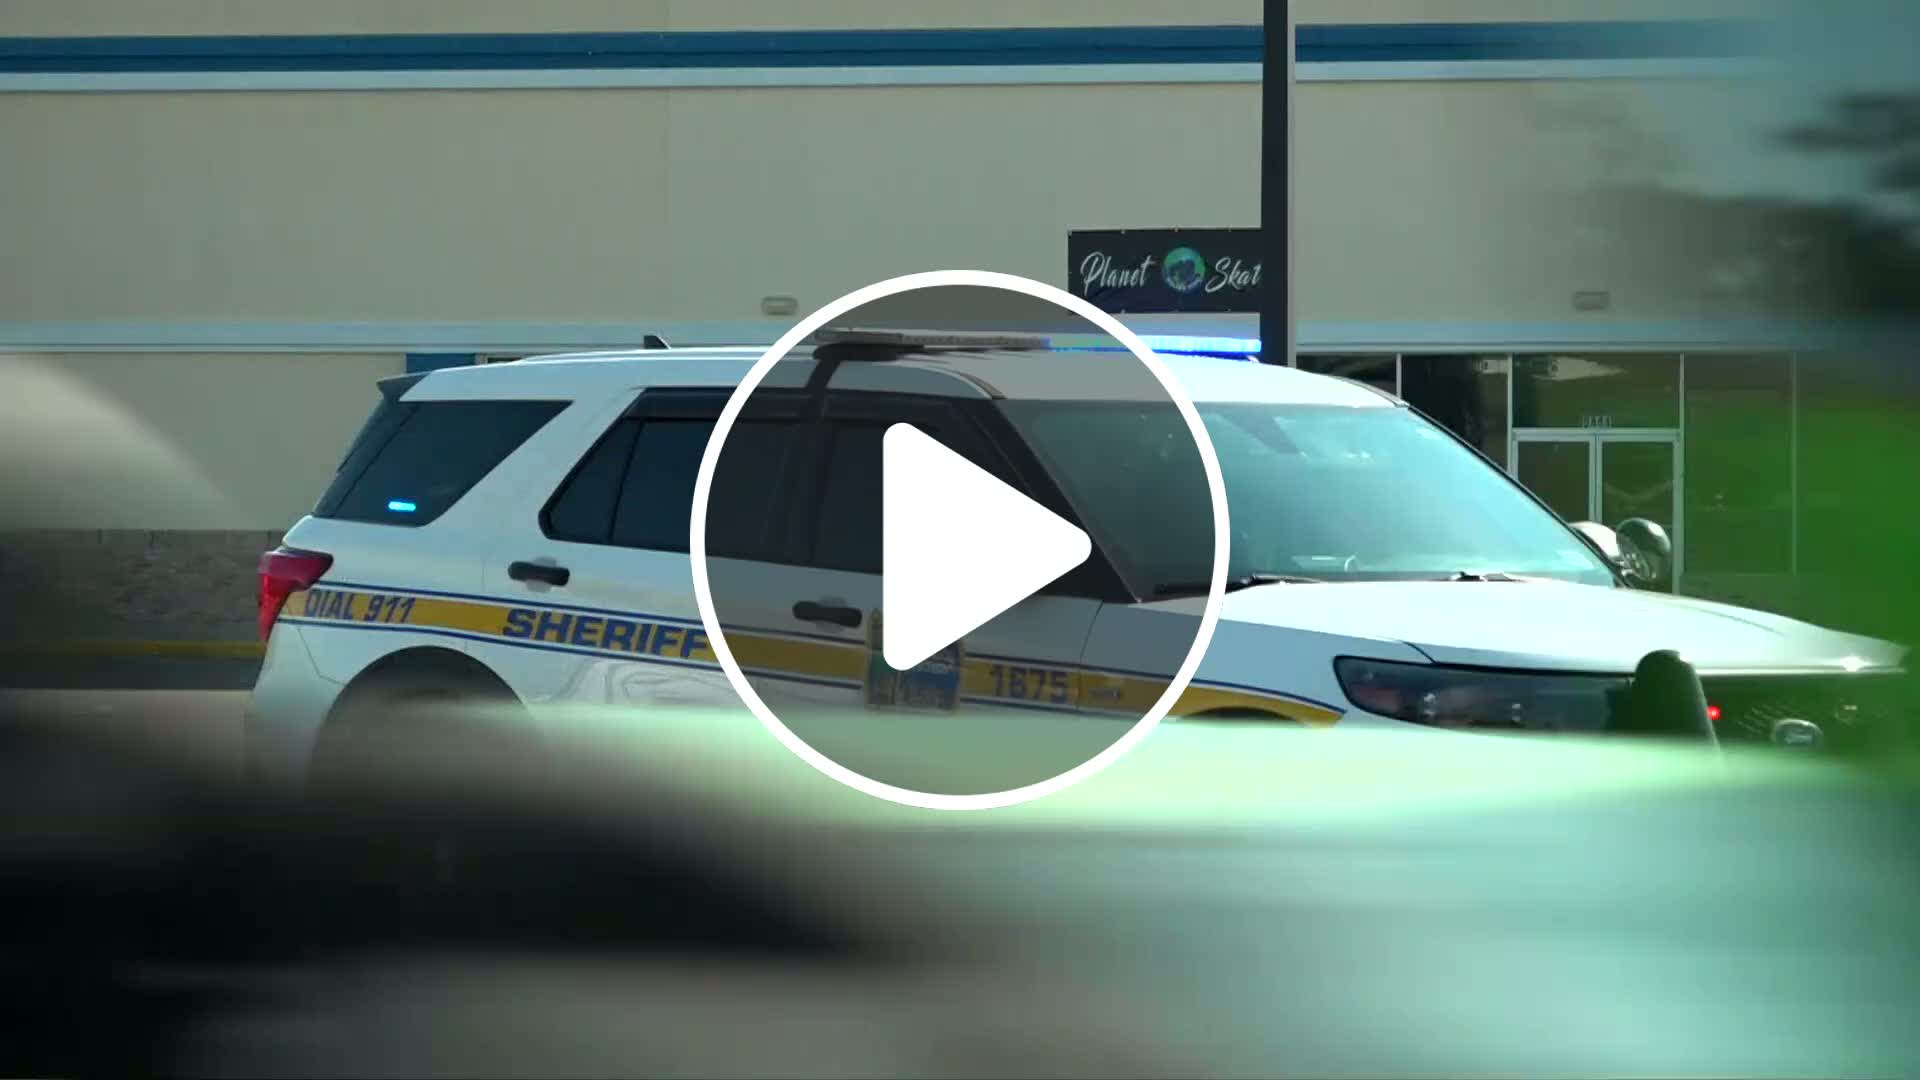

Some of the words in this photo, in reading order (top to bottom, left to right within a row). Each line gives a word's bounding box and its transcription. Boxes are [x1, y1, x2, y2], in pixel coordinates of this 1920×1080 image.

[1080, 251, 1156, 296] Planet
[304, 589, 354, 620] DIAL
[363, 594, 417, 622] 911
[502, 608, 708, 658] SHERIFF
